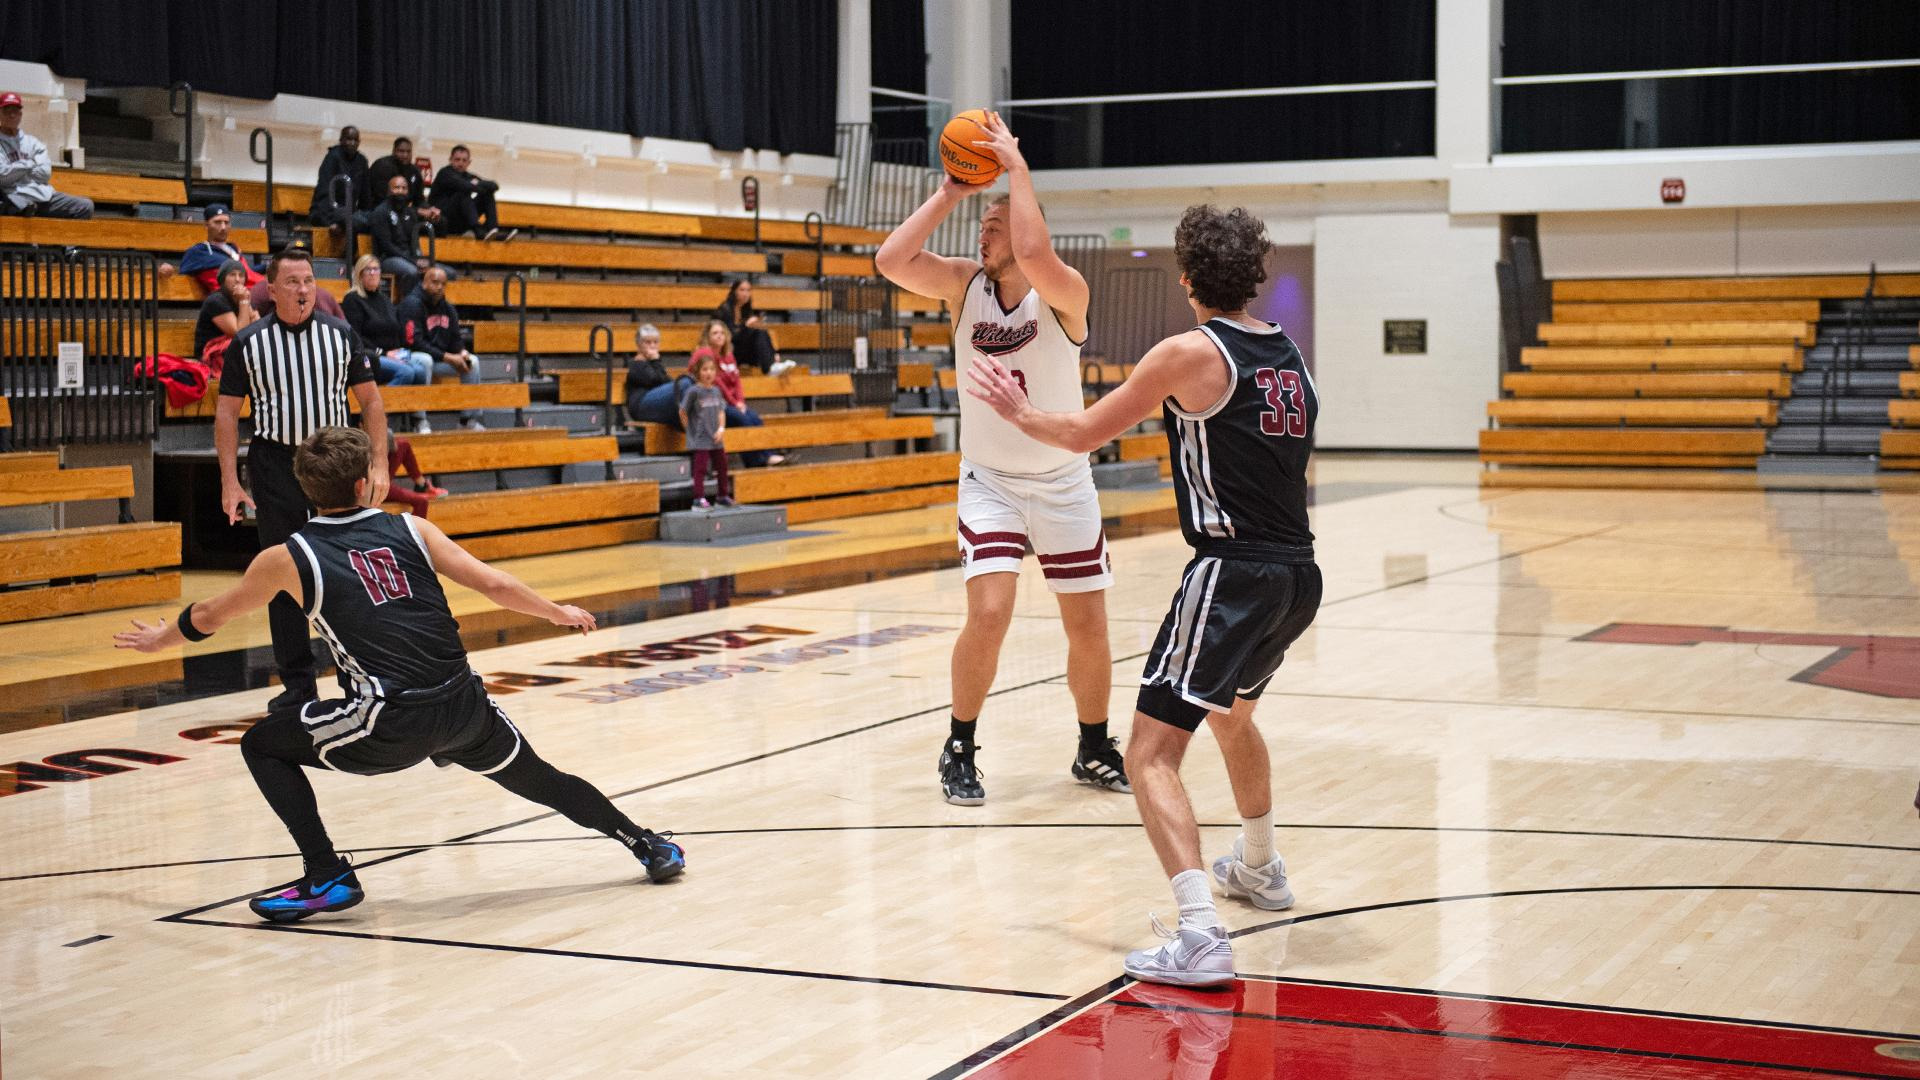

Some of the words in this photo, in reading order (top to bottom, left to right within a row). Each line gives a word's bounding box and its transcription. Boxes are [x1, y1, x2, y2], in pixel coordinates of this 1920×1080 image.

[941, 143, 978, 171] Wilson
[1255, 367, 1307, 438] 33
[348, 547, 413, 606] 10
